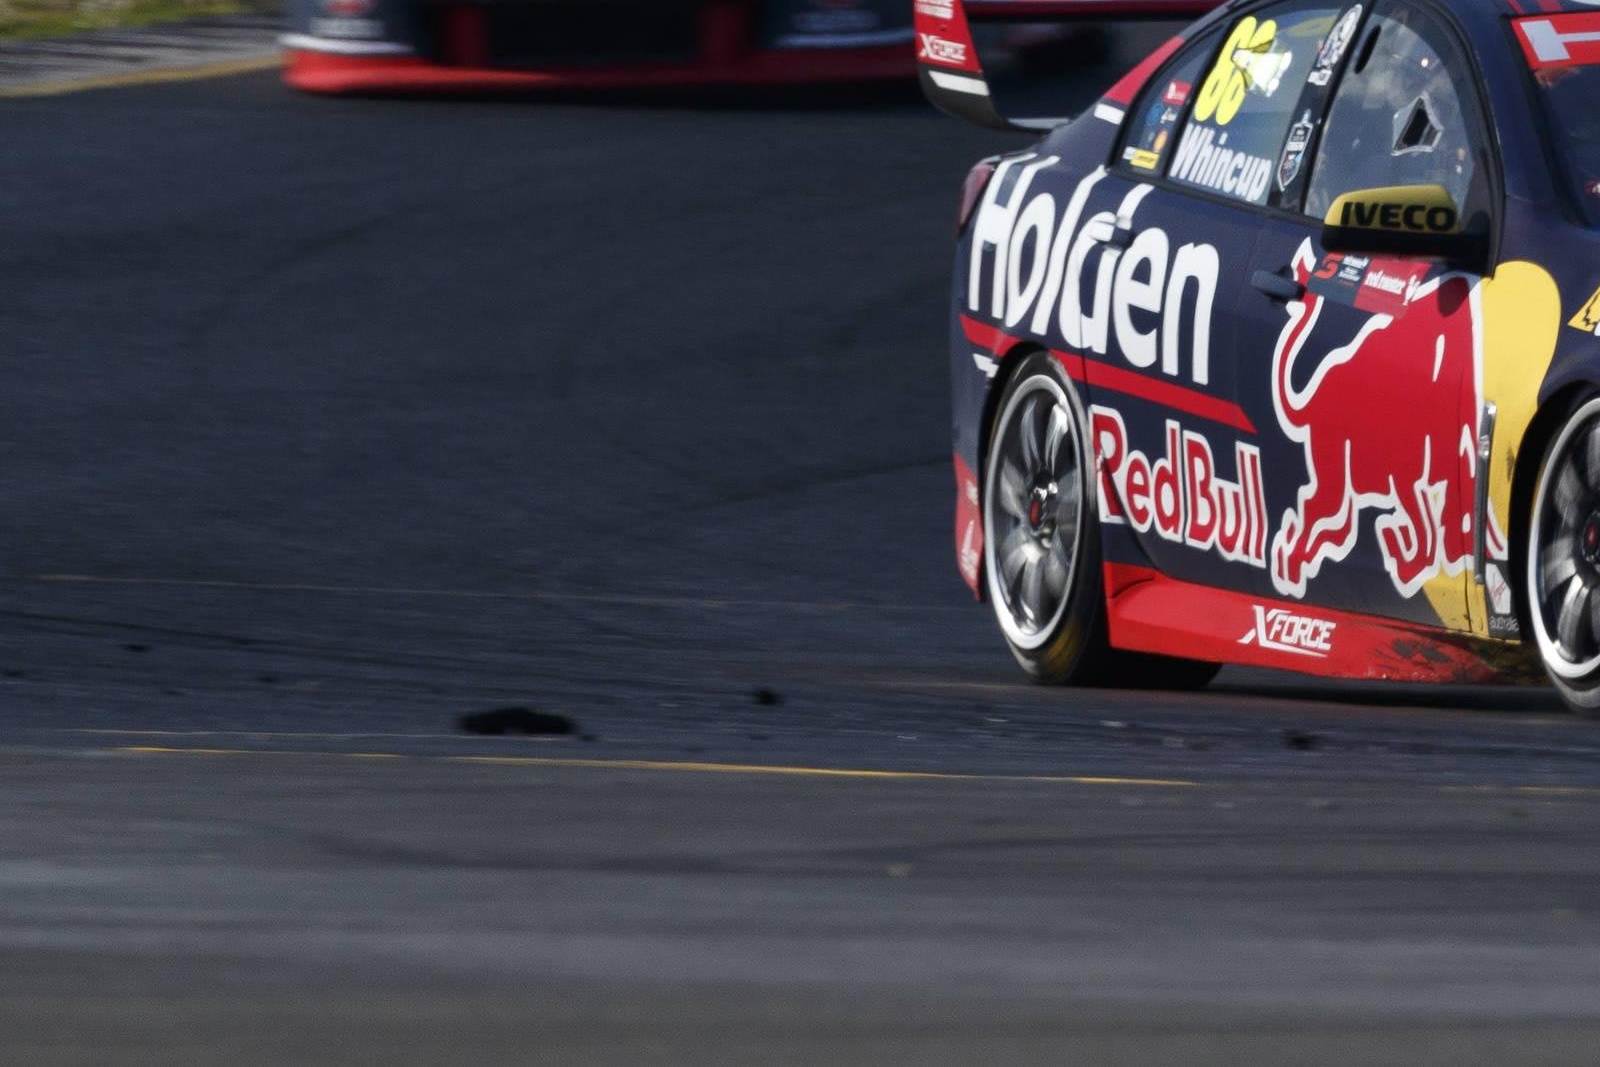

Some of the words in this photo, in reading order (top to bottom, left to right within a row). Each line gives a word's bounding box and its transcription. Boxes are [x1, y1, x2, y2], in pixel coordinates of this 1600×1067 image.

[1168, 122, 1272, 202] Whincup
[1340, 201, 1458, 232] IVECO
[968, 152, 1220, 386] Holden
[1088, 404, 1184, 543] Red
[1182, 429, 1267, 568] Bull
